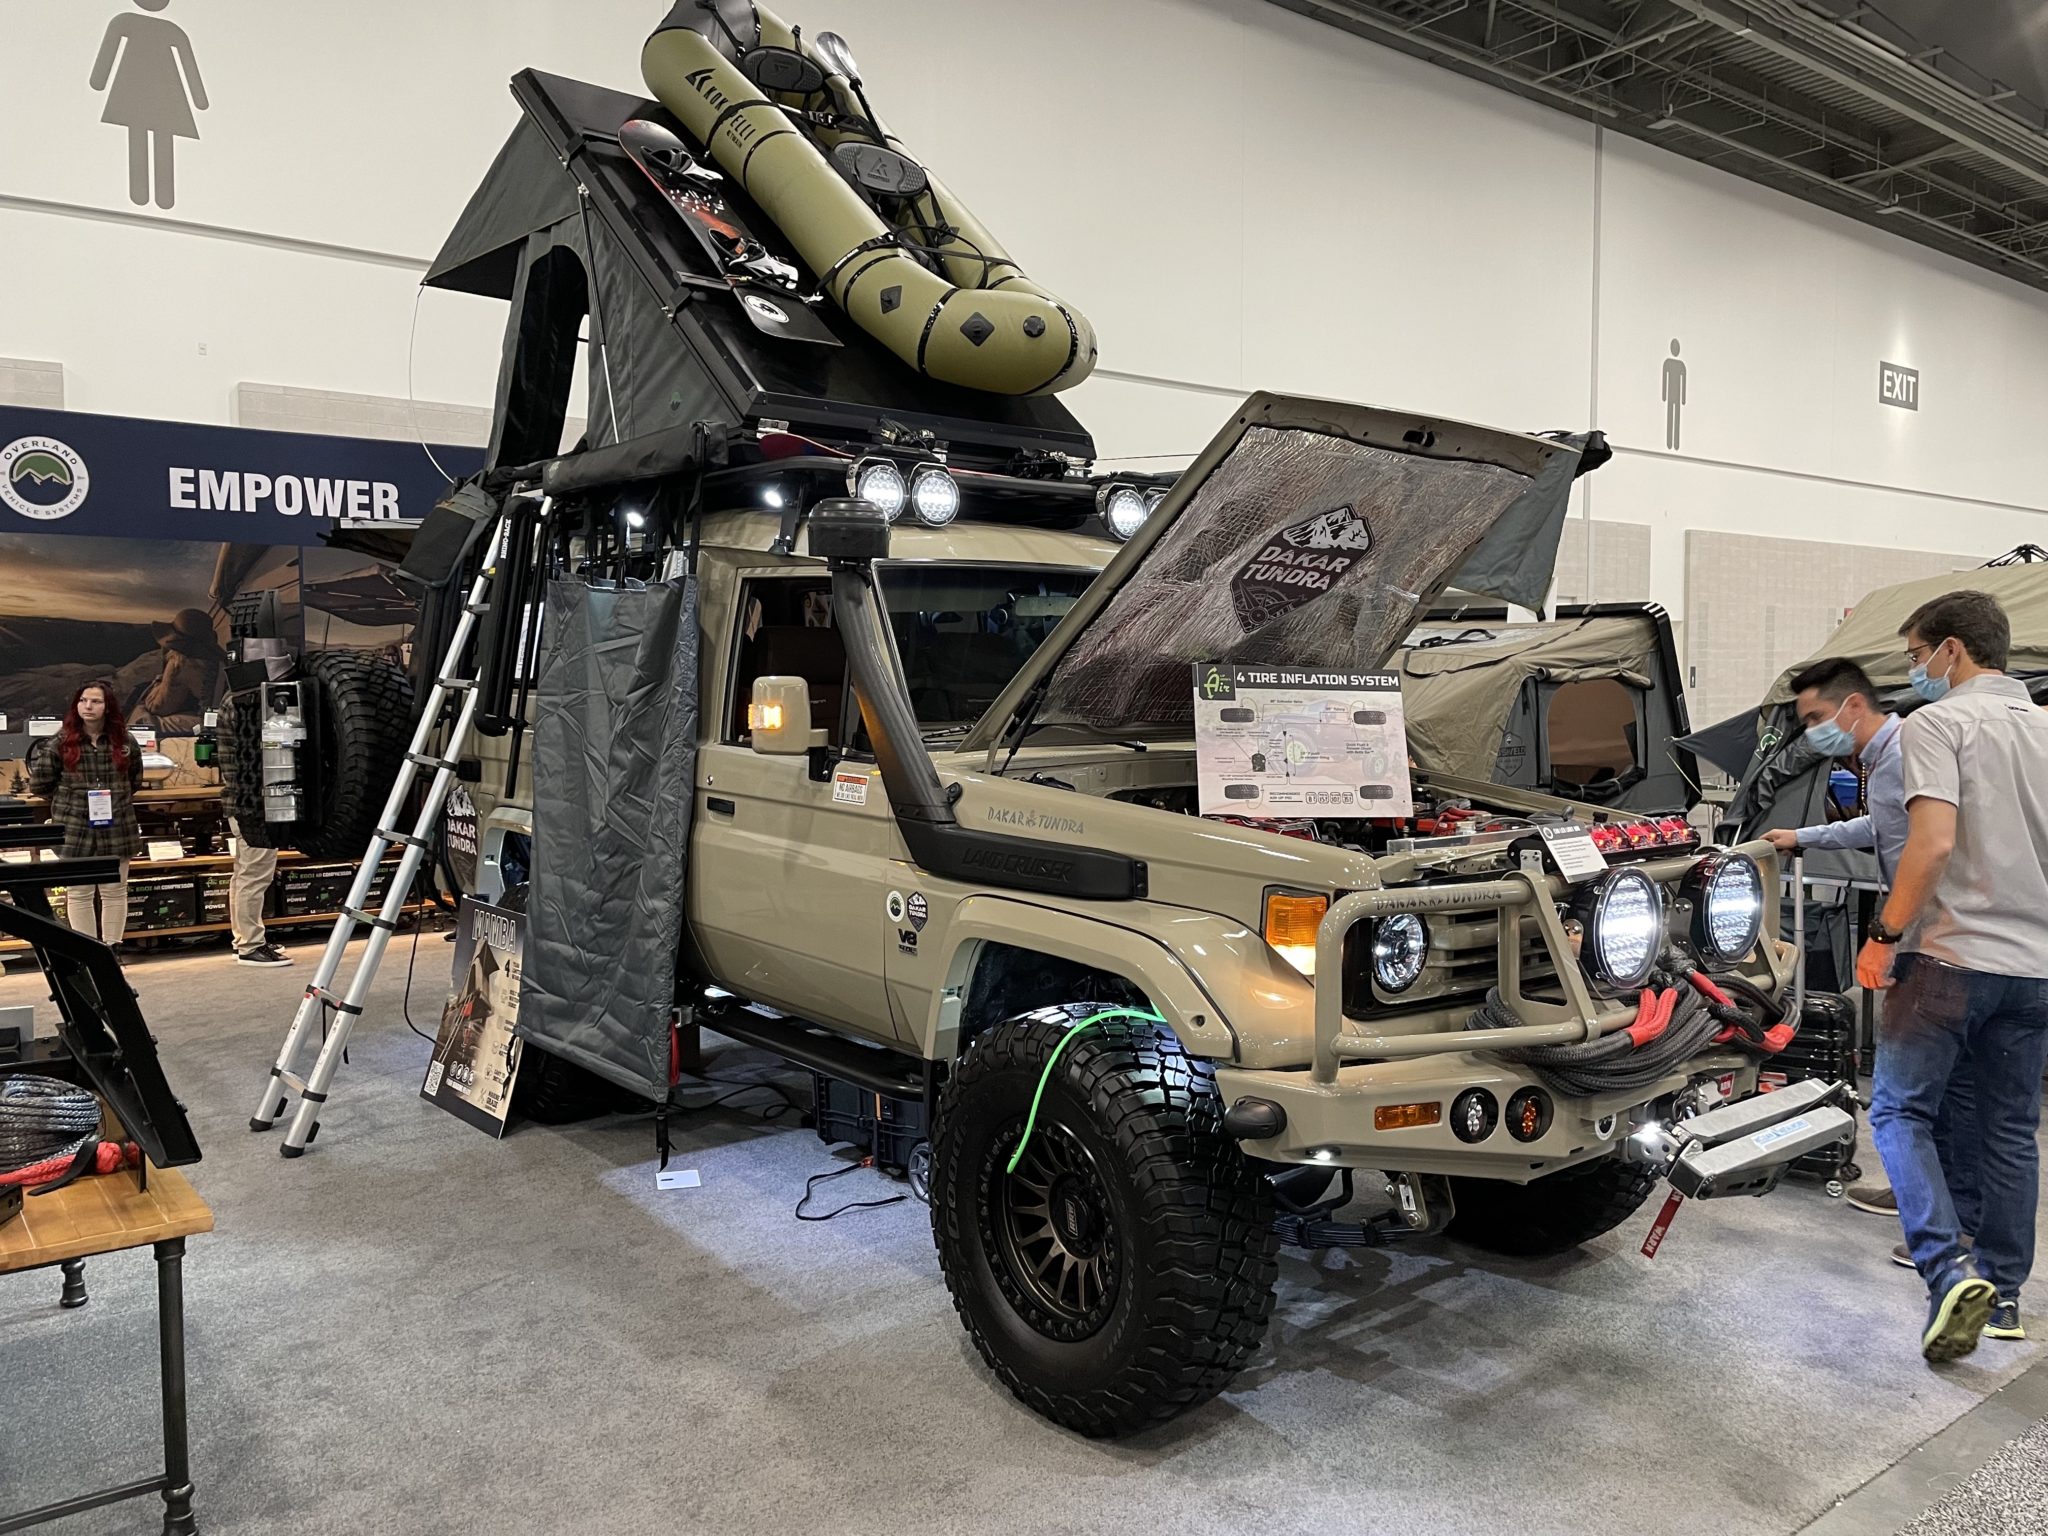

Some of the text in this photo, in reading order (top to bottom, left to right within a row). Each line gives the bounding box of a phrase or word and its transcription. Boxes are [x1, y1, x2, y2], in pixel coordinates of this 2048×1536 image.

[703, 87, 756, 140] KOKELLI
[1884, 370, 1916, 402] EXIT
[4, 440, 77, 464] OVERLAND
[2, 484, 82, 516] VEHICLE SYSTEMS
[169, 467, 400, 519] EMPOWER
[1257, 546, 1350, 573] DAKAR
[1243, 563, 1331, 590] TUNDRA
[1236, 672, 1245, 683] 4
[1248, 672, 1278, 684] TIRE
[1280, 673, 1347, 686] INFLATION
[1350, 675, 1399, 687] SYSTEM
[987, 806, 1085, 834] DAKAR TUNDRA
[960, 848, 1074, 882] LAND CRUISER
[908, 904, 926, 912] DAKAR
[1377, 889, 1502, 910] DAKAR TUNDRA
[472, 909, 516, 954] MAMBA
[898, 928, 917, 946] V8
[505, 960, 511, 978] 4
[1644, 1225, 1666, 1254] WARN
